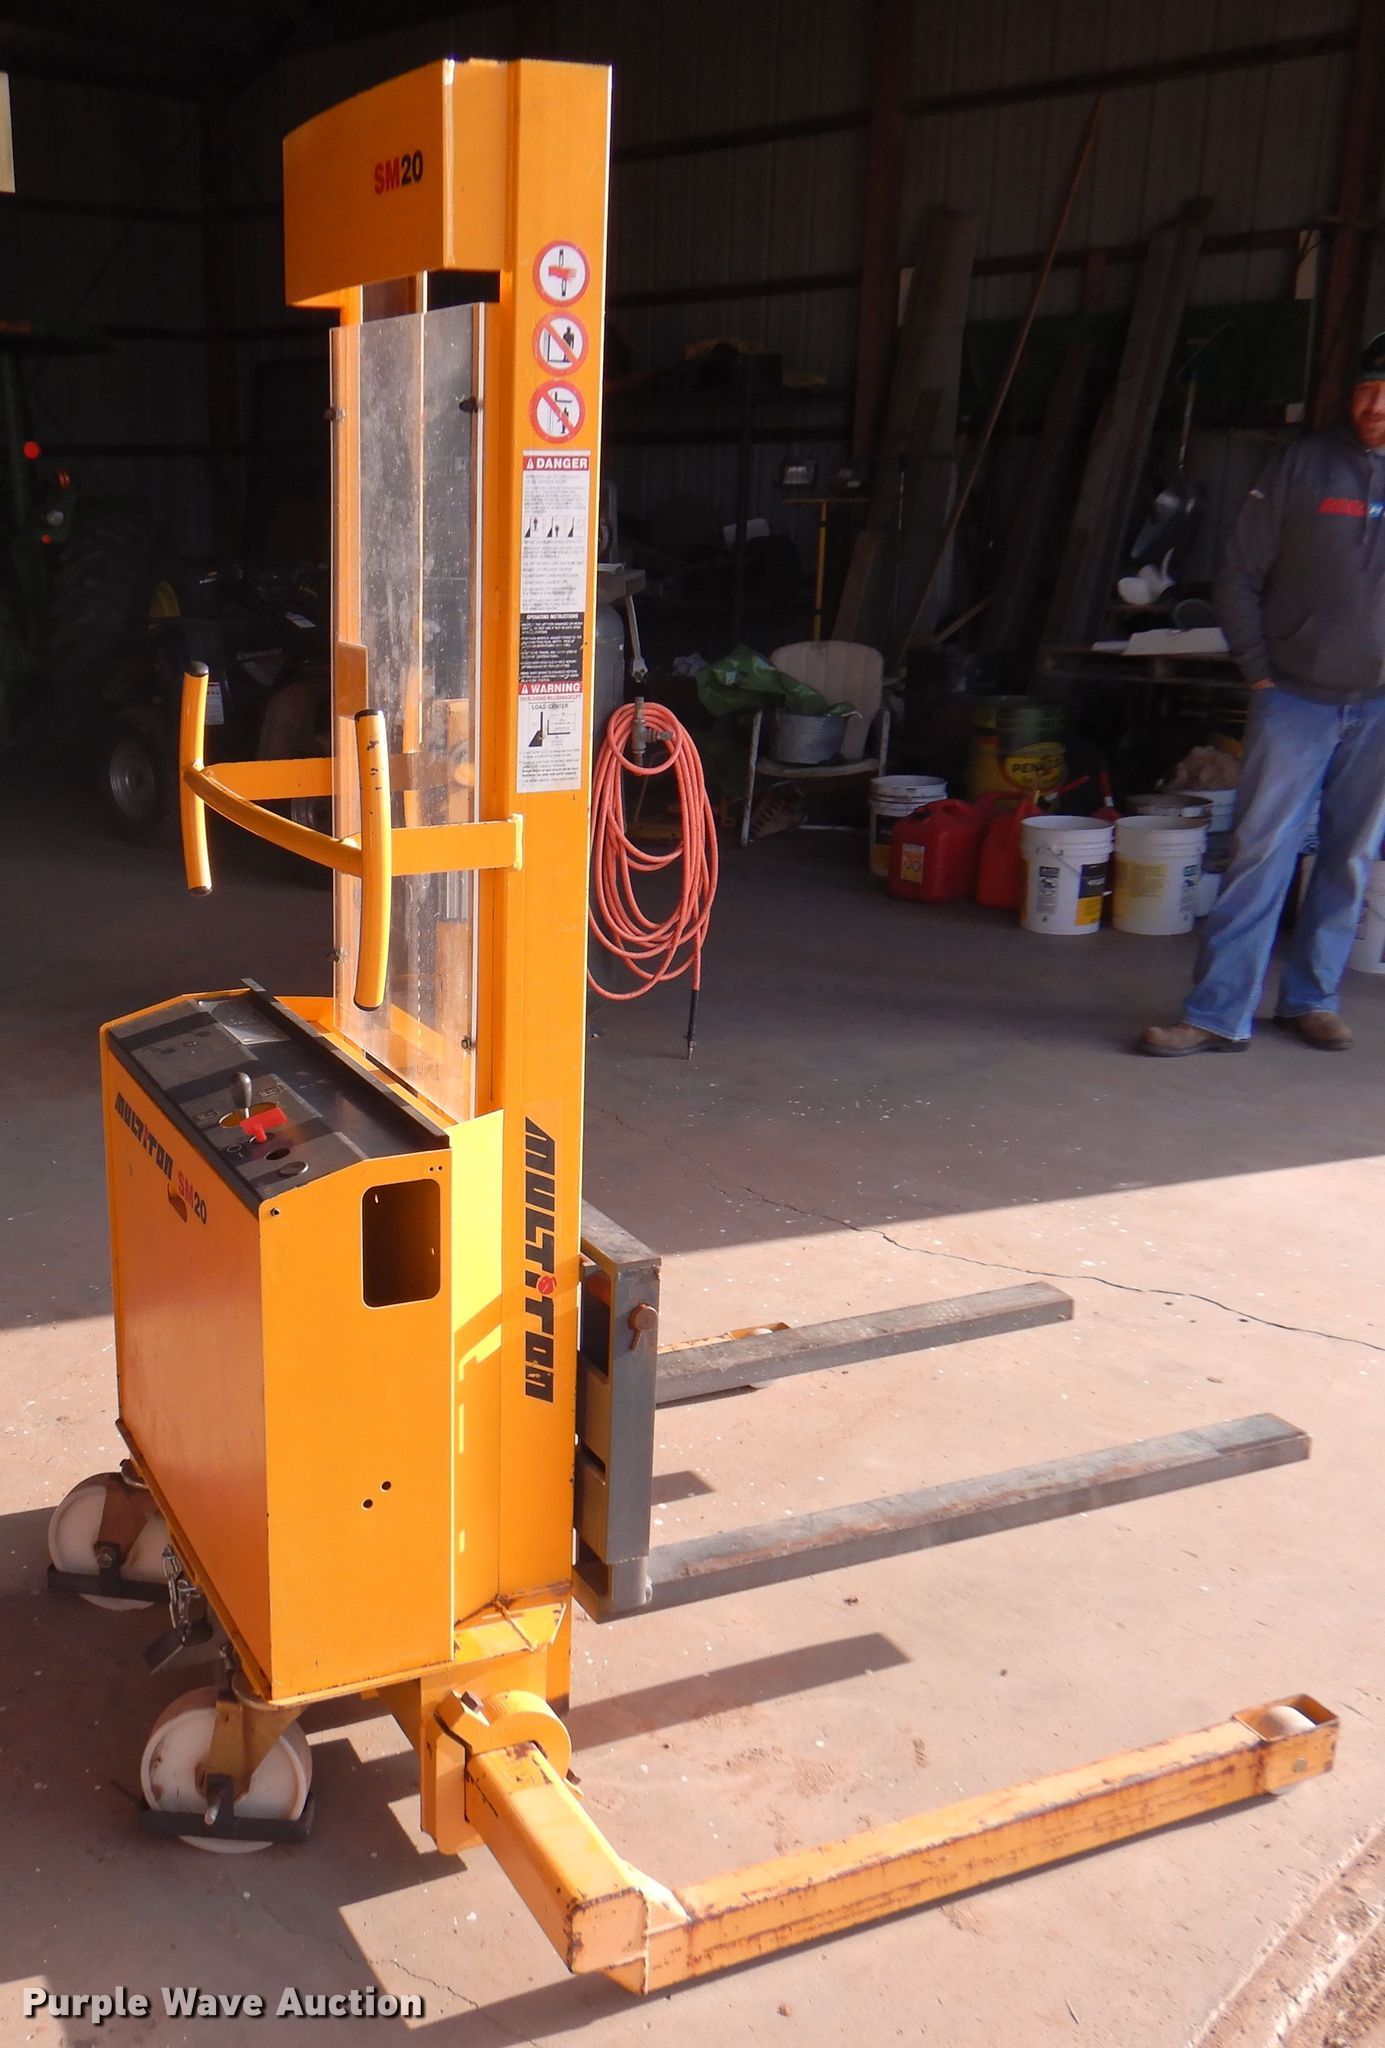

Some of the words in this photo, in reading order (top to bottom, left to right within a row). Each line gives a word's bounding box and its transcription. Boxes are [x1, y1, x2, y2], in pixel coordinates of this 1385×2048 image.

[374, 149, 424, 195] SM20
[536, 457, 588, 470] DANGER
[530, 683, 581, 694] WARNING
[178, 1170, 207, 1225] SM20
